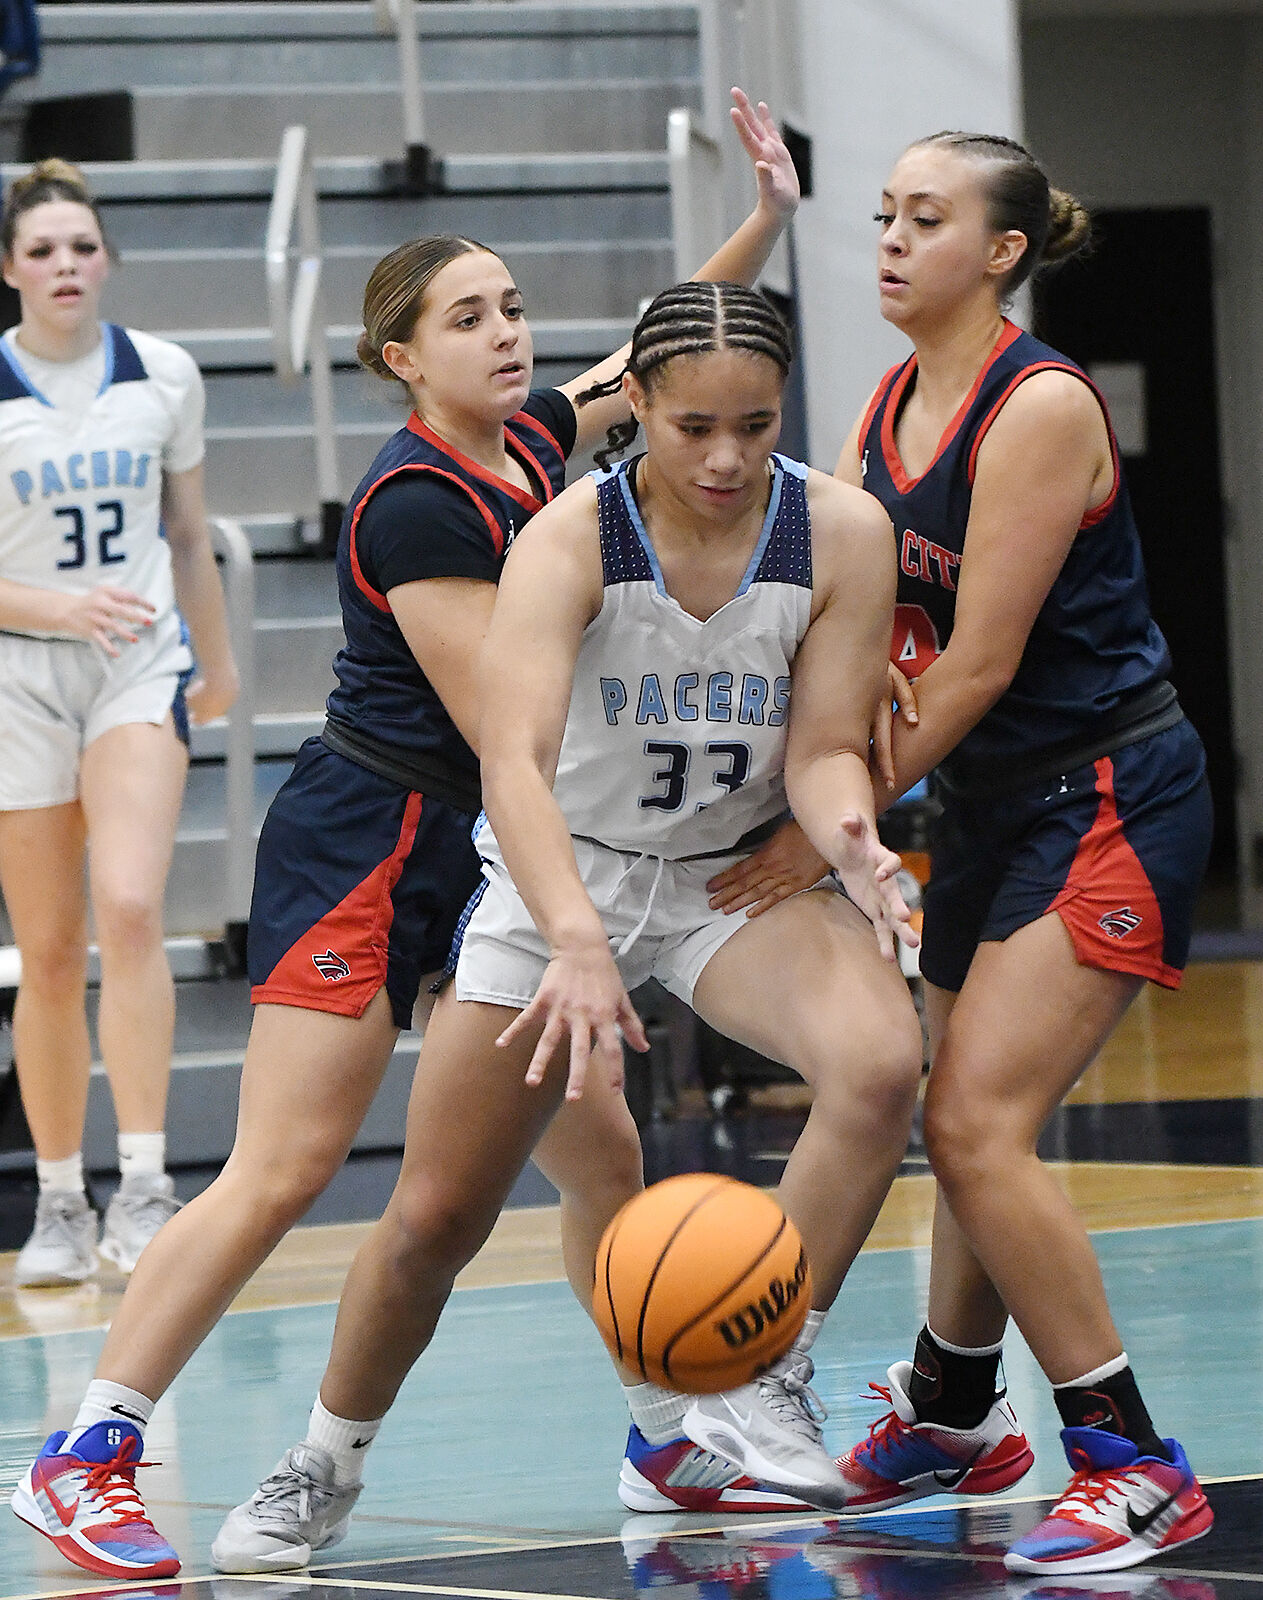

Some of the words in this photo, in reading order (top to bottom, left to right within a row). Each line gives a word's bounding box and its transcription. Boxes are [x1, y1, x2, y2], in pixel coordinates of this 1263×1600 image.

[53, 499, 126, 571] 32
[901, 528, 963, 591] CIT
[600, 671, 792, 727] PACERS
[637, 739, 752, 814] 33
